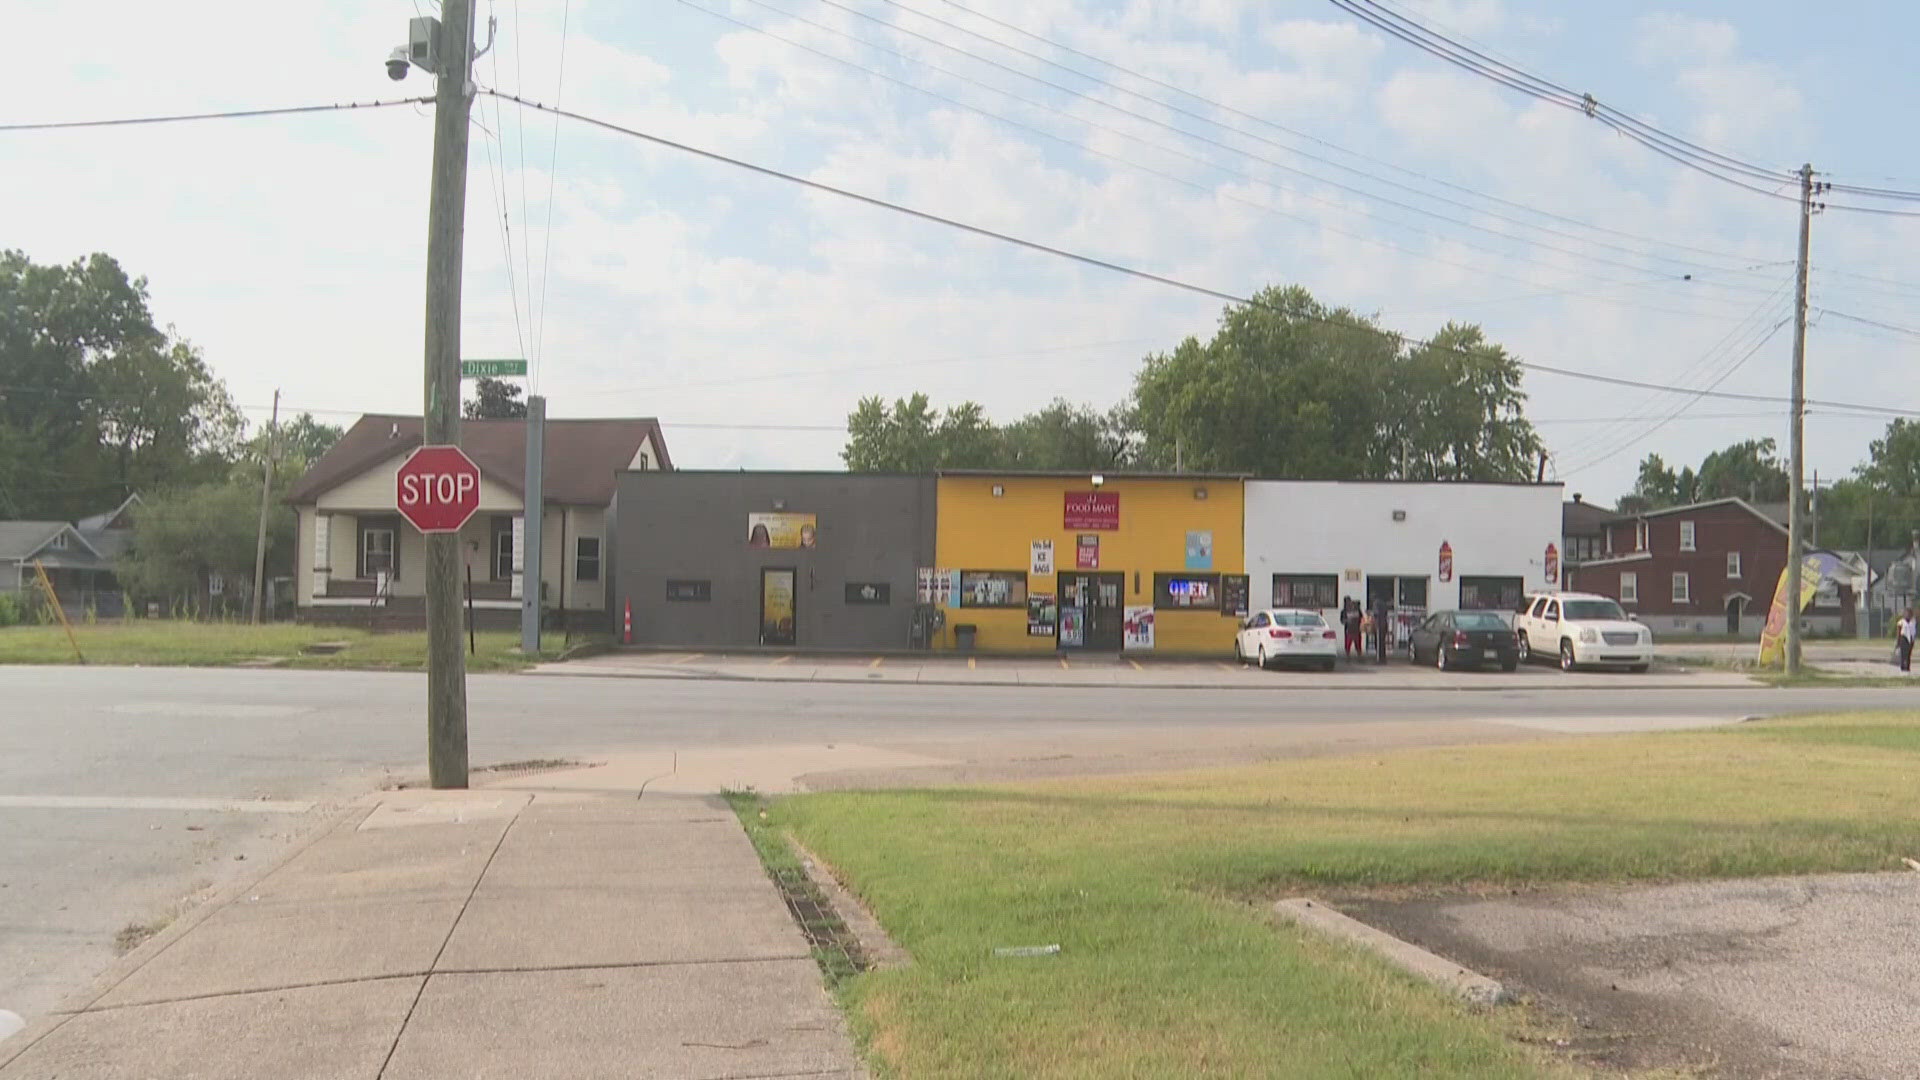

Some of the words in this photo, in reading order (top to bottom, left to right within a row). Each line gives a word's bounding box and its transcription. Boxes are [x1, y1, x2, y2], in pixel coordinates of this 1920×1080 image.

[402, 473, 474, 504] STOP
[1066, 503, 1091, 513] FOOD
[1092, 503, 1115, 513] MART
[1037, 552, 1047, 562] ICE
[1033, 564, 1050, 574] BAGS
[1168, 579, 1209, 598] OPEN
